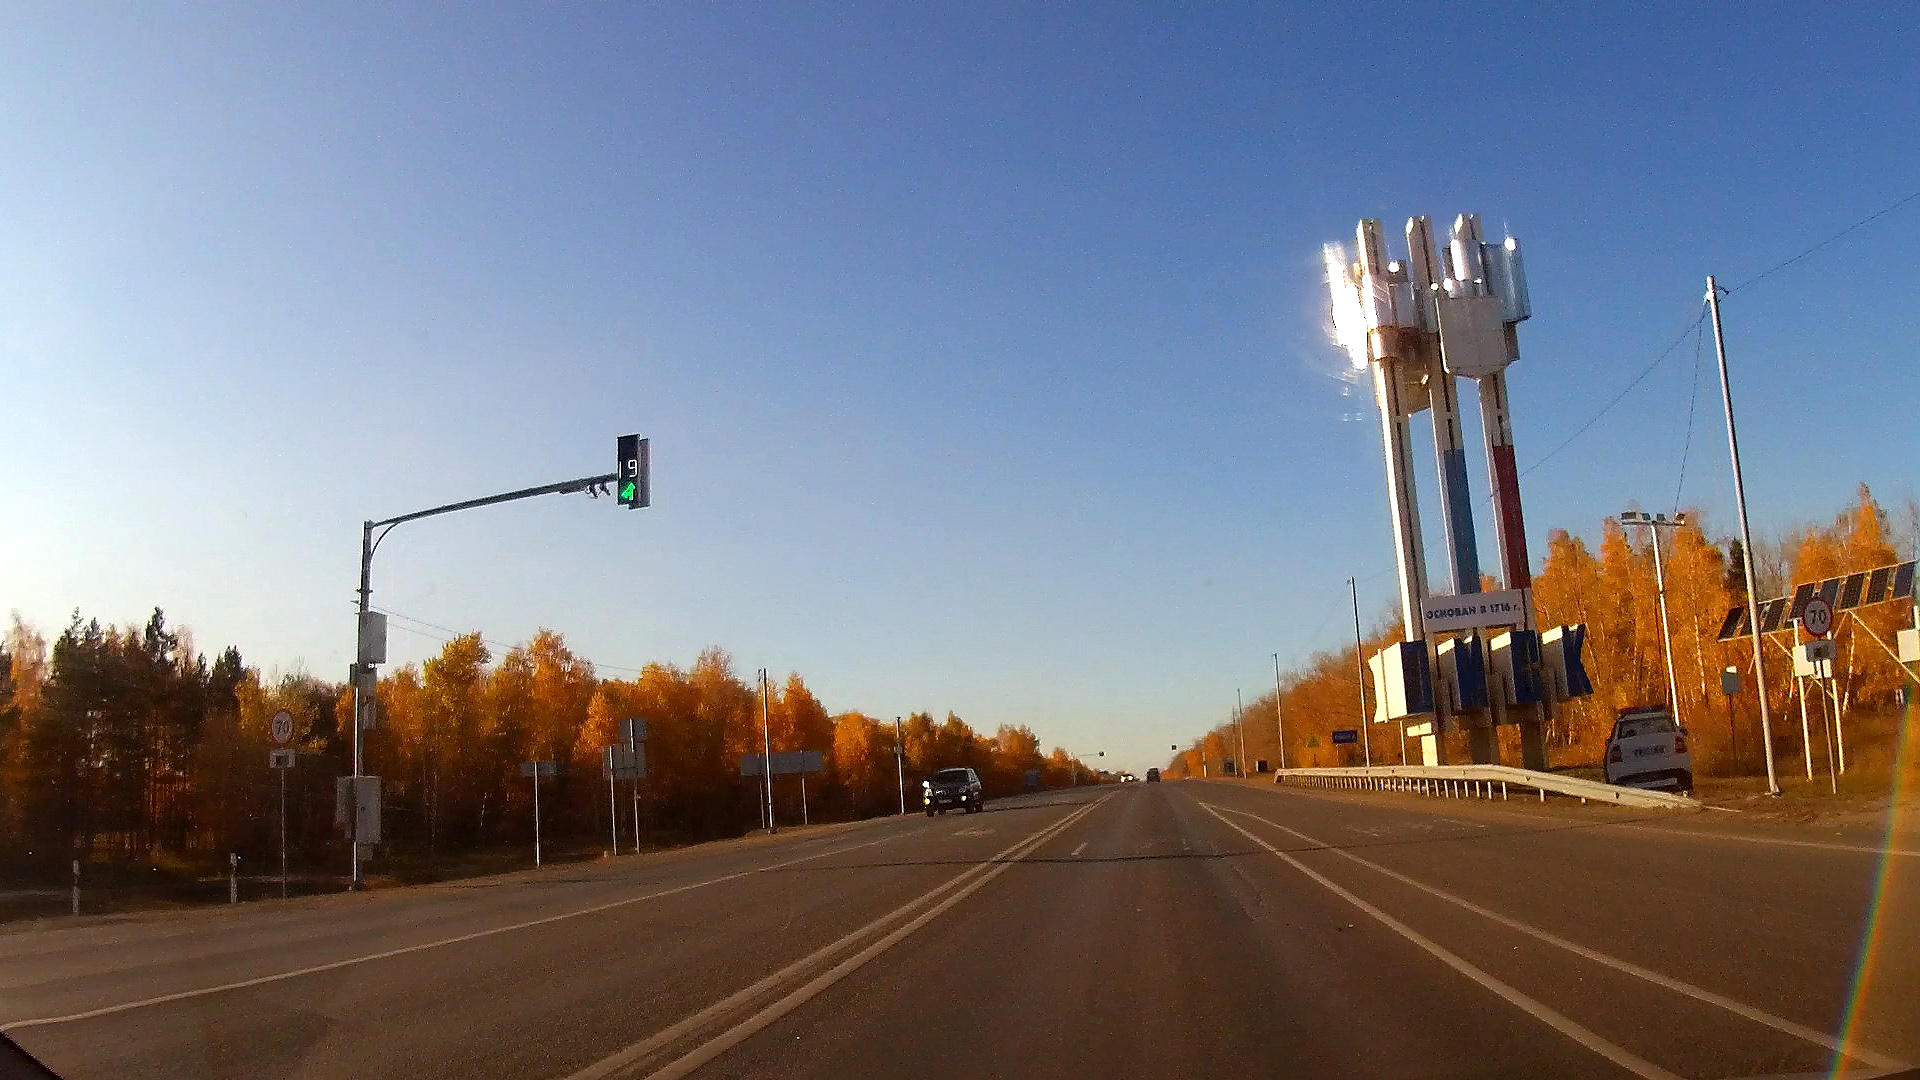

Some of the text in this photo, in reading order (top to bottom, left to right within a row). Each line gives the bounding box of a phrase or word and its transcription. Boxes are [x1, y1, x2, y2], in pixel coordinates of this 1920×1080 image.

[619, 459, 638, 479] 19
[1425, 606, 1477, 620] ОСНОВАН
[1490, 602, 1511, 613] 1716
[1809, 609, 1827, 625] 70
[275, 720, 290, 735] 70
